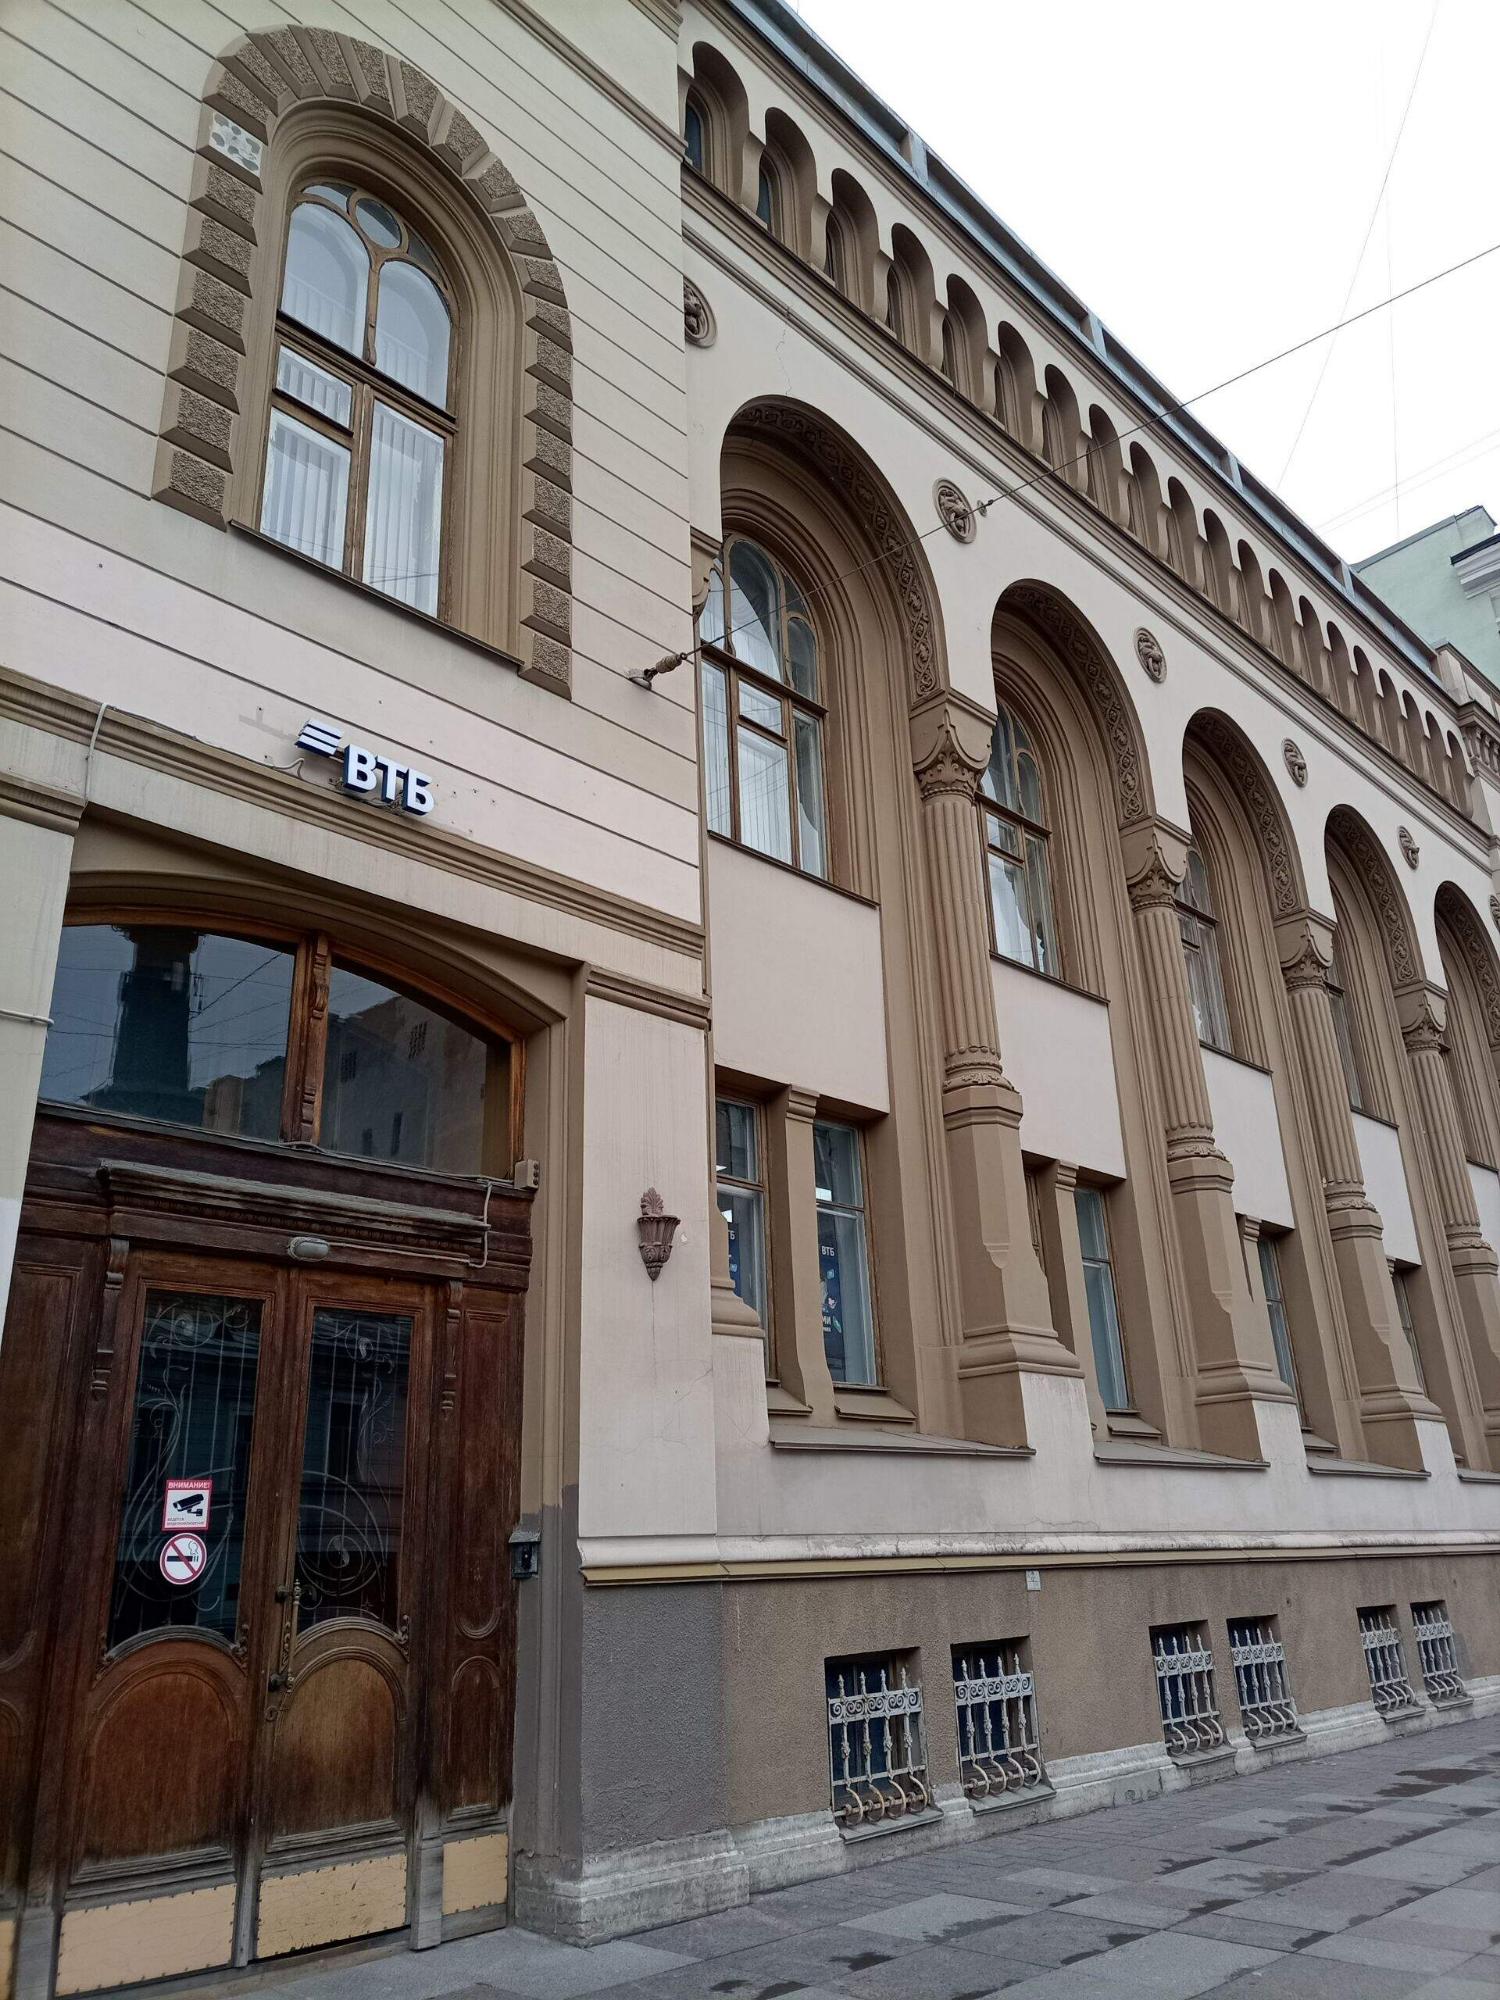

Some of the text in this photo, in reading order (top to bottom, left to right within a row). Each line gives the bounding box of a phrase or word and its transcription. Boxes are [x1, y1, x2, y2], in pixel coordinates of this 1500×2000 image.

[343, 744, 435, 816] ВТБ
[821, 1245, 835, 1257] ВТБ
[168, 1481, 211, 1489] ВНИМАНИЕ!
